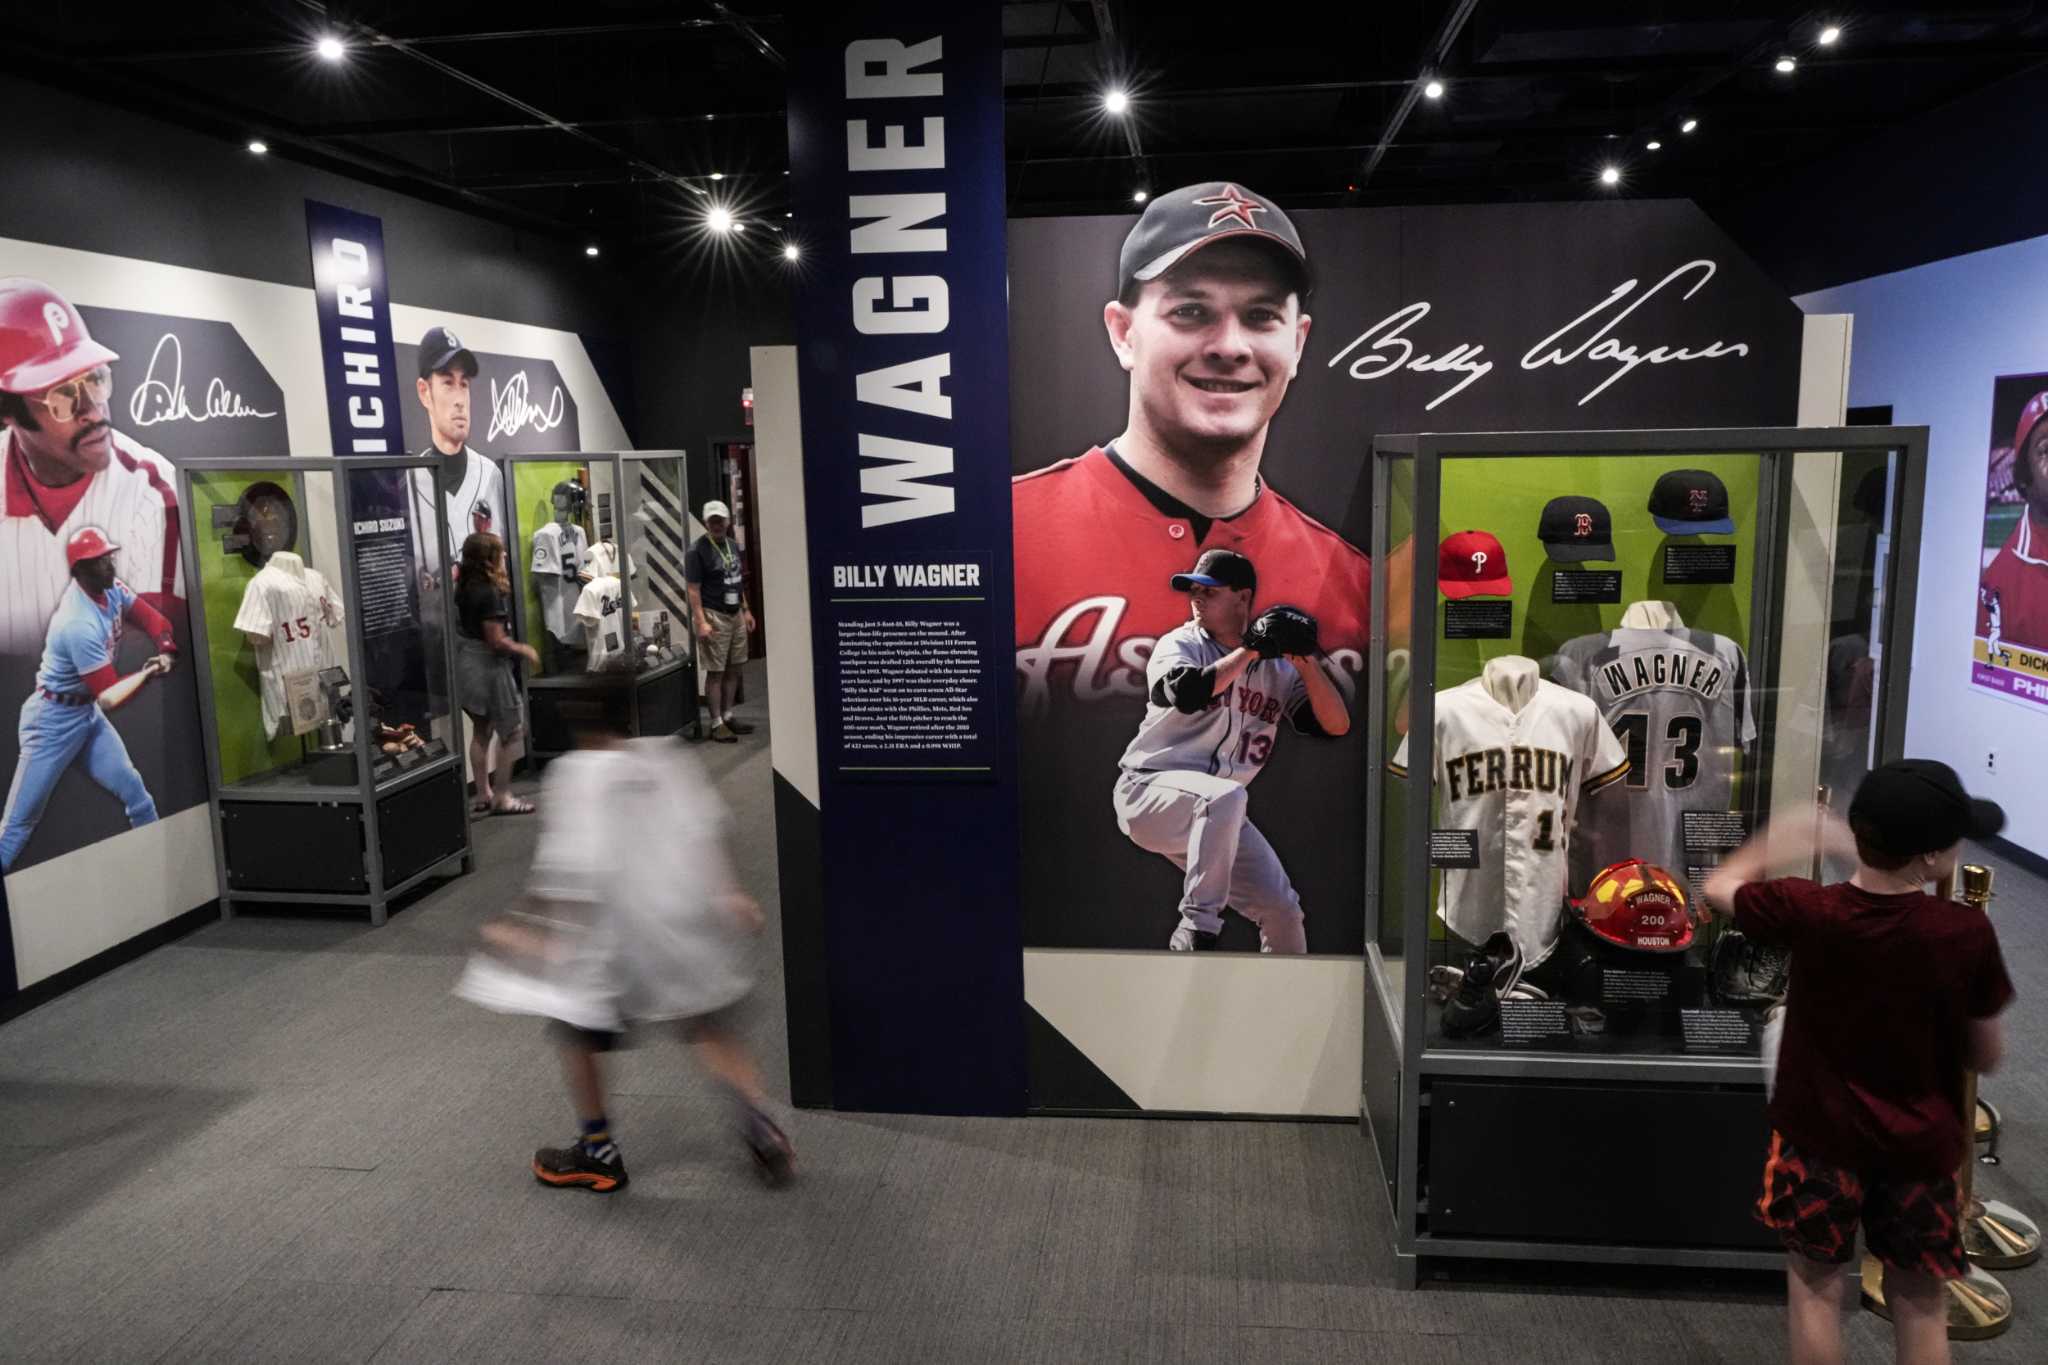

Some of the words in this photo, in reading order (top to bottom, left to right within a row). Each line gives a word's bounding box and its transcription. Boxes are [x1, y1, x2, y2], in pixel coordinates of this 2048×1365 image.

[844, 34, 956, 528] WAGNER
[331, 238, 387, 453] ICHIRO
[1328, 301, 1493, 411] Billy
[833, 565, 887, 588] BILLY
[894, 564, 980, 588] WAGNER
[1471, 551, 1488, 574] P
[282, 617, 310, 643] 15
[1603, 653, 1722, 698] WAGNER
[2020, 653, 2048, 674] DICK
[1237, 731, 1273, 767] 13
[1610, 712, 1703, 790] 13
[1532, 809, 1568, 852] 1
[1635, 892, 1672, 906] WAGNER
[1641, 914, 1666, 926] 200
[1637, 936, 1671, 947] HOUSTON
